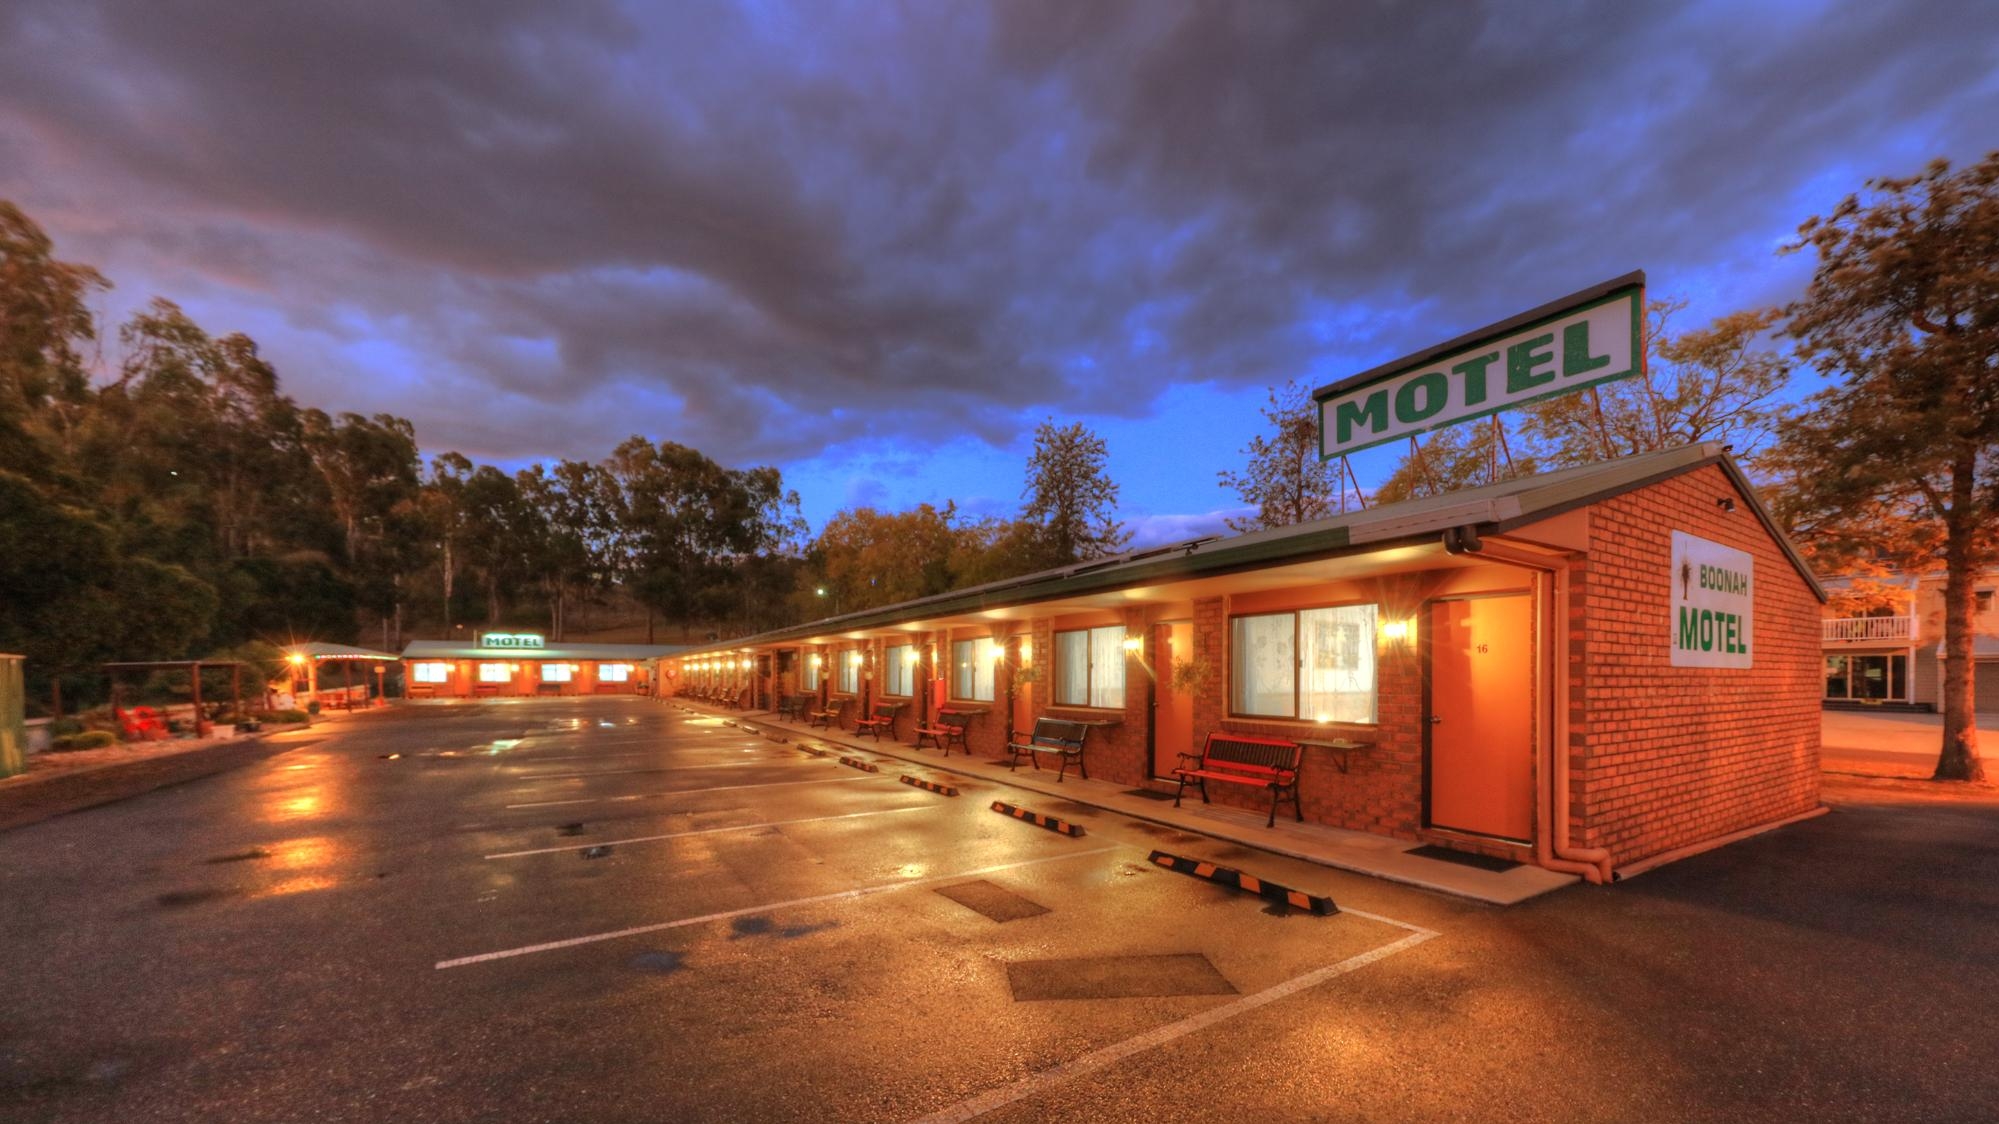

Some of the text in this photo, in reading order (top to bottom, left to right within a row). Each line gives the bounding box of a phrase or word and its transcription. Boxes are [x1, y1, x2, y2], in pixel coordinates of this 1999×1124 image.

[1336, 320, 1611, 444] MOTEL
[1700, 564, 1748, 596] BOONAH
[485, 637, 540, 646] MOTEL
[1679, 606, 1746, 655] MOTEL
[1476, 644, 1488, 654] 16
